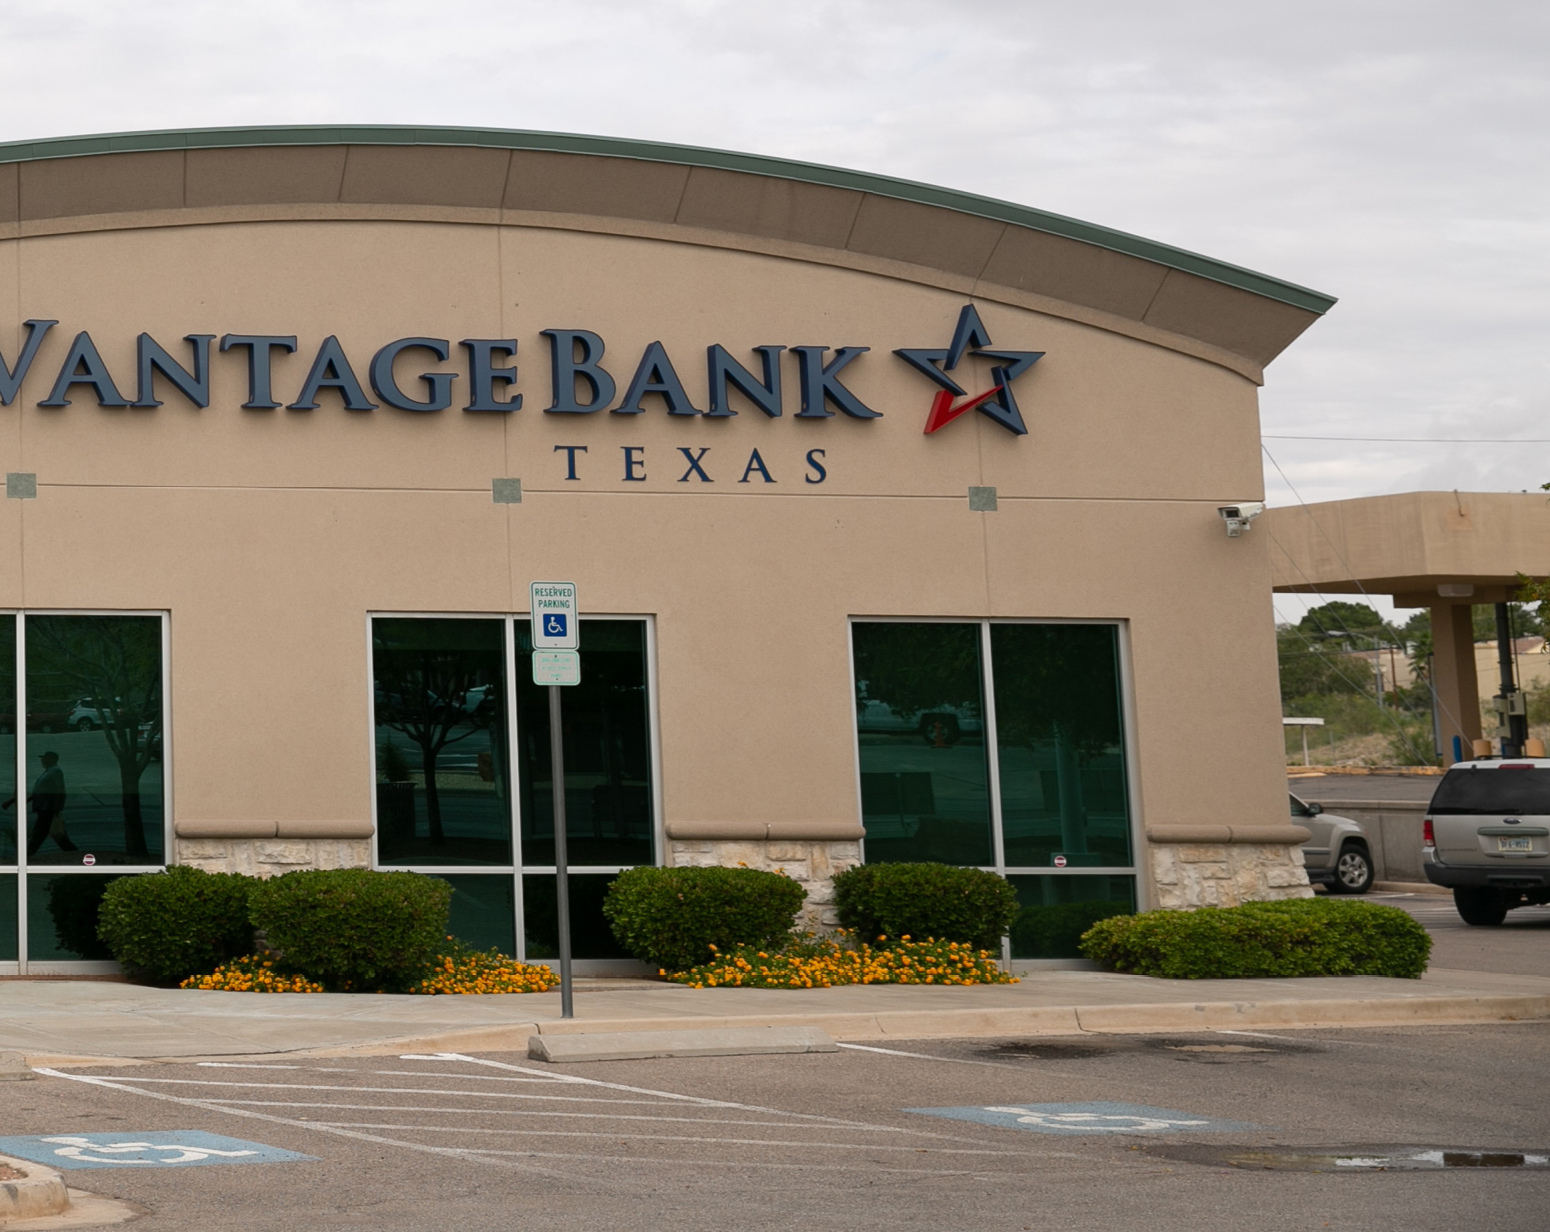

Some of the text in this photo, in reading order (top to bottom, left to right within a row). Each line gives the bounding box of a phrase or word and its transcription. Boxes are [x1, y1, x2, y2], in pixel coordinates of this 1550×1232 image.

[538, 328, 884, 419] BANK
[553, 445, 828, 484] TEXAS
[534, 588, 572, 597] RESERVED
[538, 600, 570, 608] PARKING
